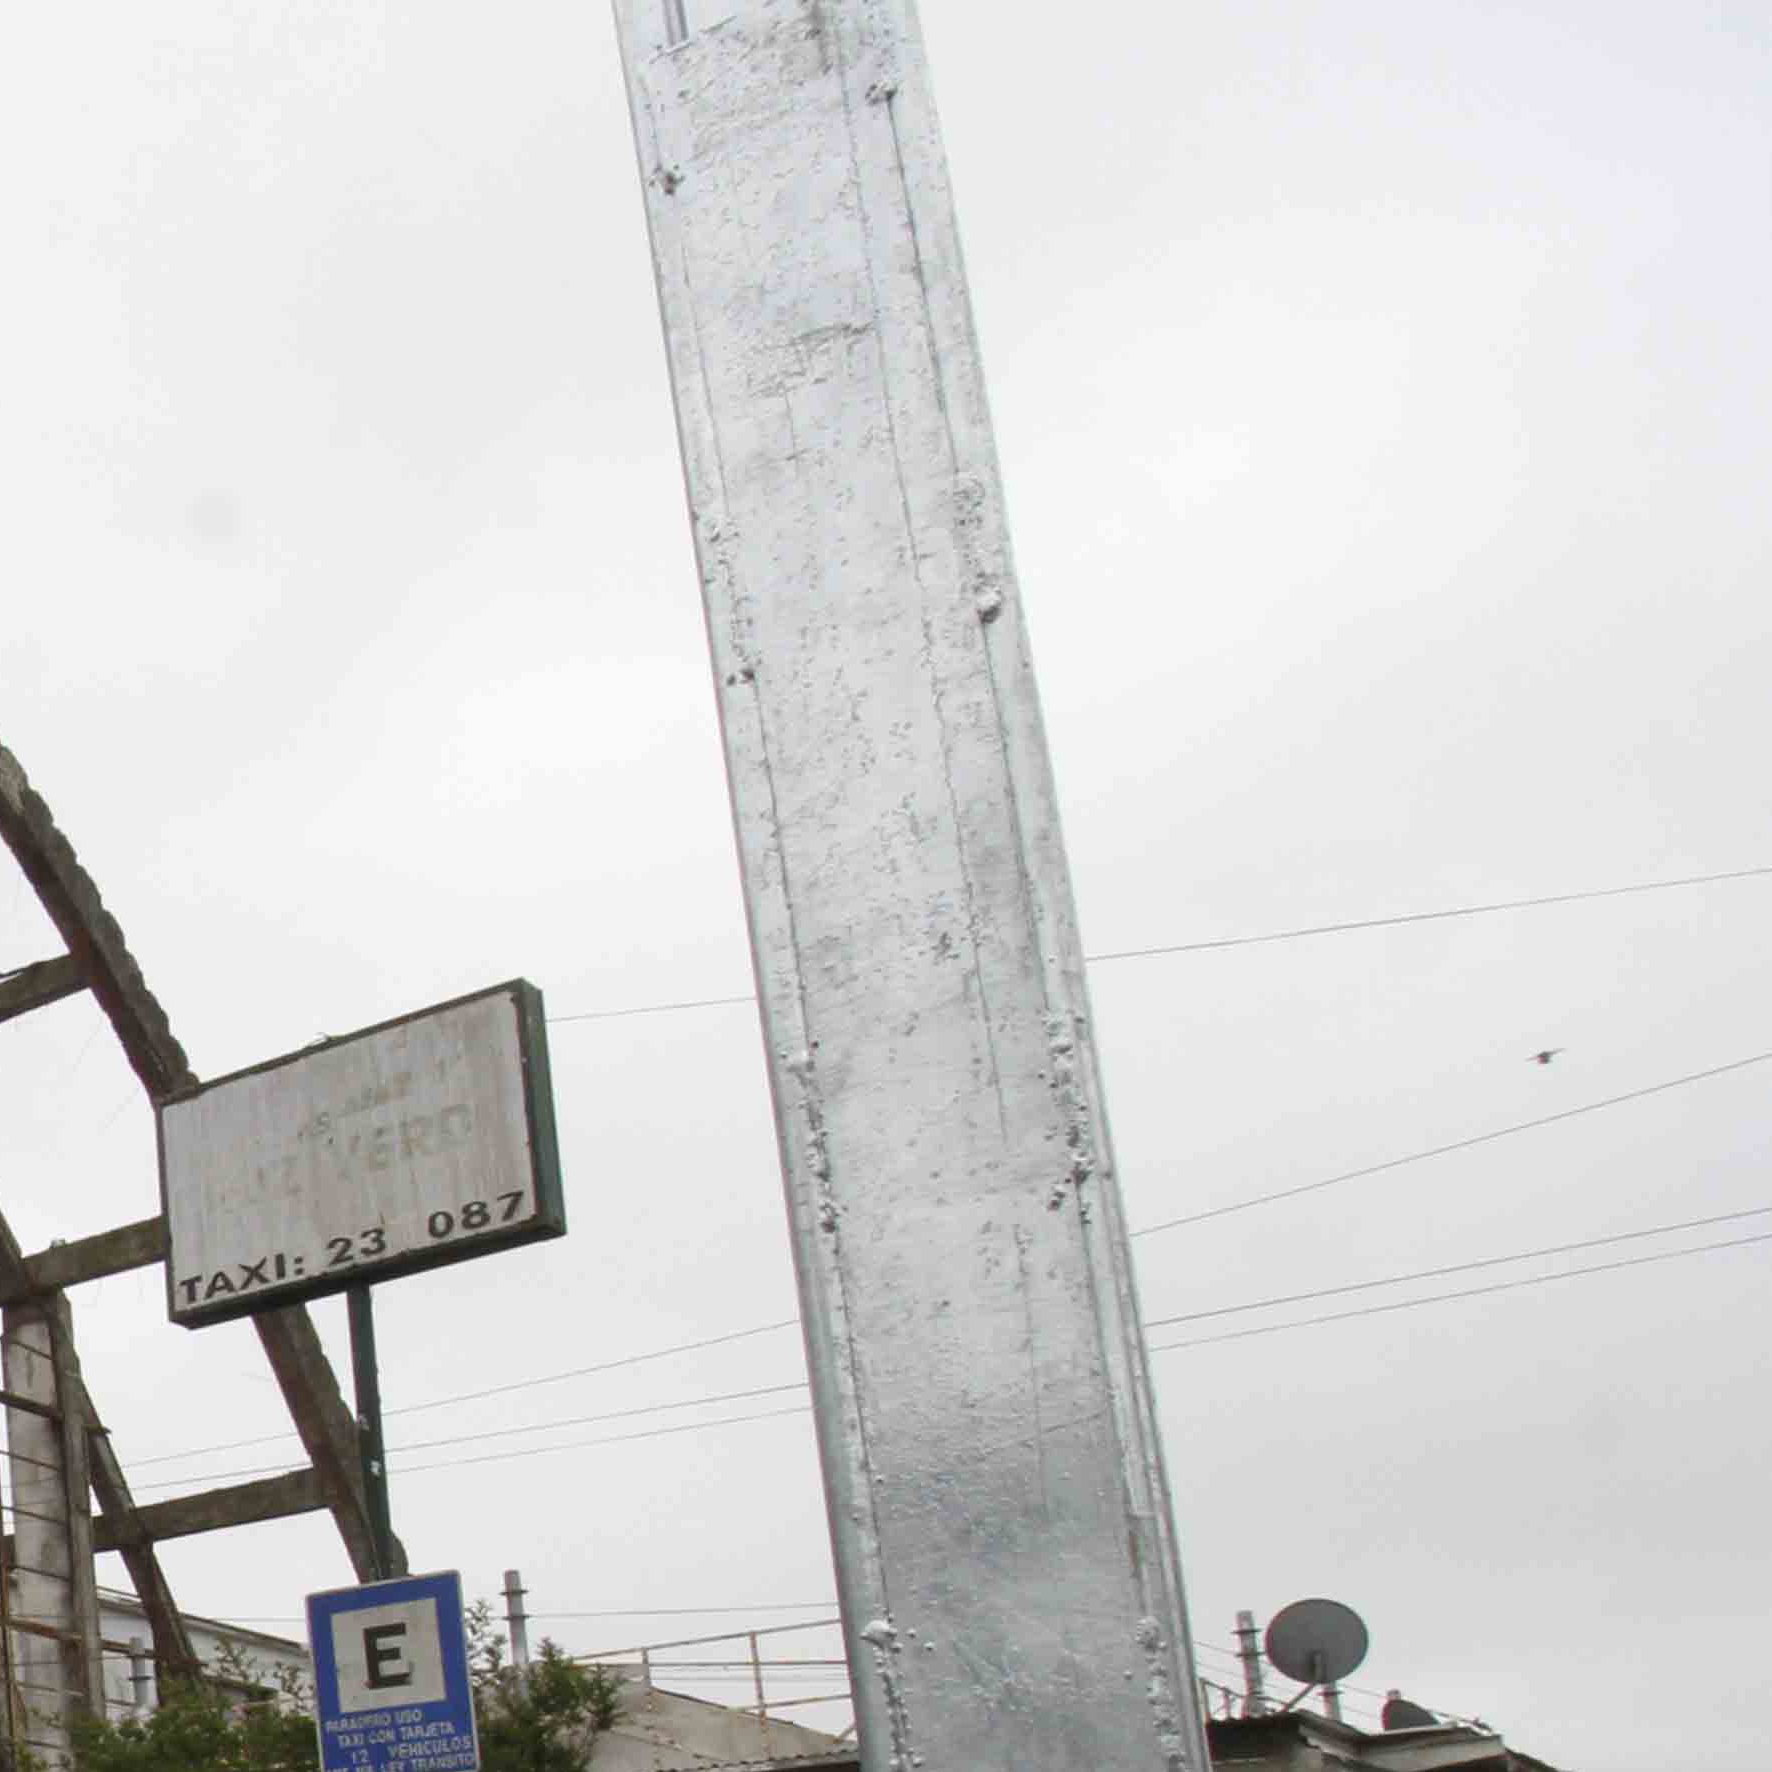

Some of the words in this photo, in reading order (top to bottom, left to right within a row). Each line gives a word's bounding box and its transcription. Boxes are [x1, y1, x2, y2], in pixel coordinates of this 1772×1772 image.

[179, 1252, 306, 1304] TAXI:
[326, 1227, 387, 1266] 23
[427, 1190, 524, 1239] 087
[362, 1622, 412, 1690] E
[386, 1735, 472, 1759] VEHICULOS
